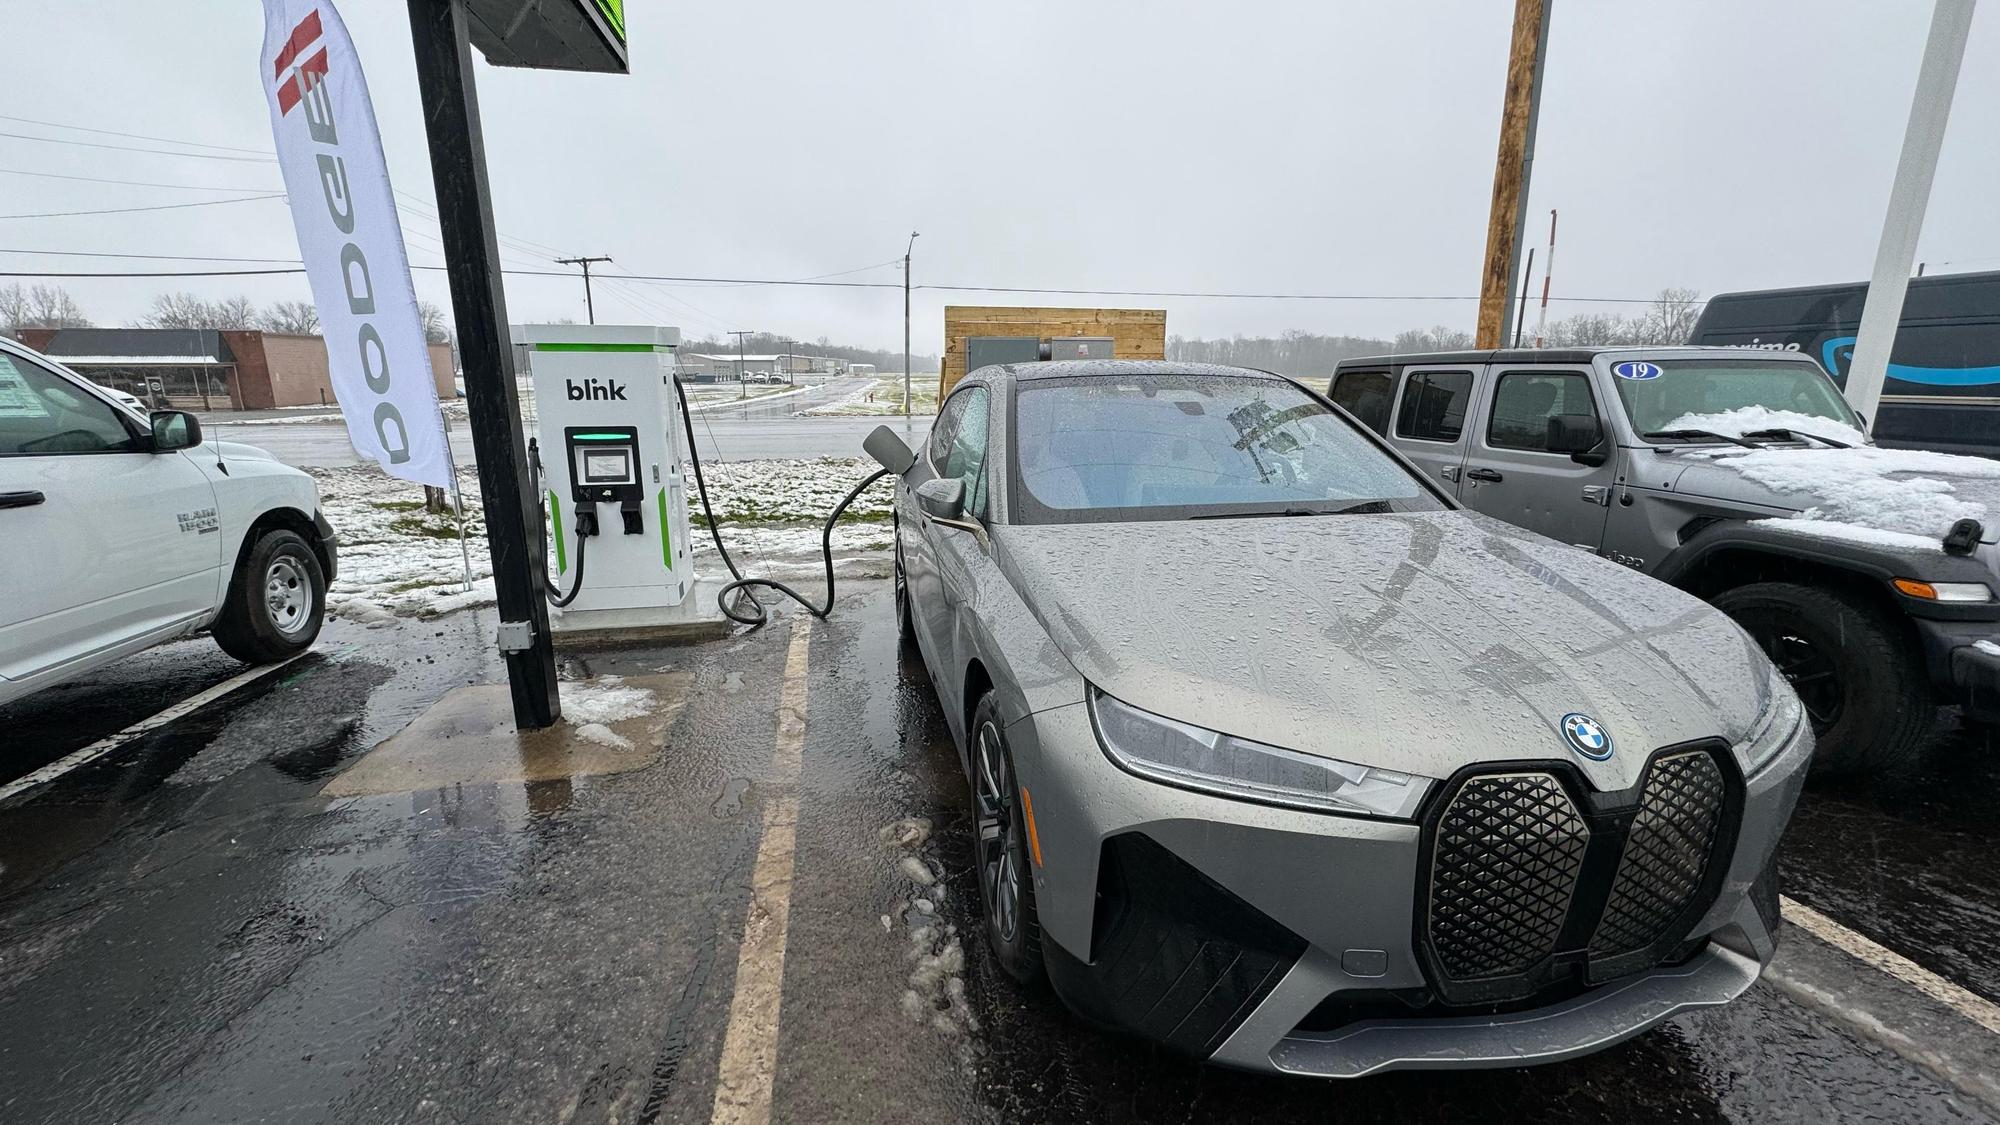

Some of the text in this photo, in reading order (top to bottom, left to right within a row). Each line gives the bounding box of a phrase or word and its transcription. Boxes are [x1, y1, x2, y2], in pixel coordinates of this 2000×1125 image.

[294, 66, 410, 465] DODGE
[1724, 337, 1801, 352] rime
[1630, 363, 1648, 378] 19
[566, 378, 628, 401] blink
[1606, 550, 1644, 569] Jeep
